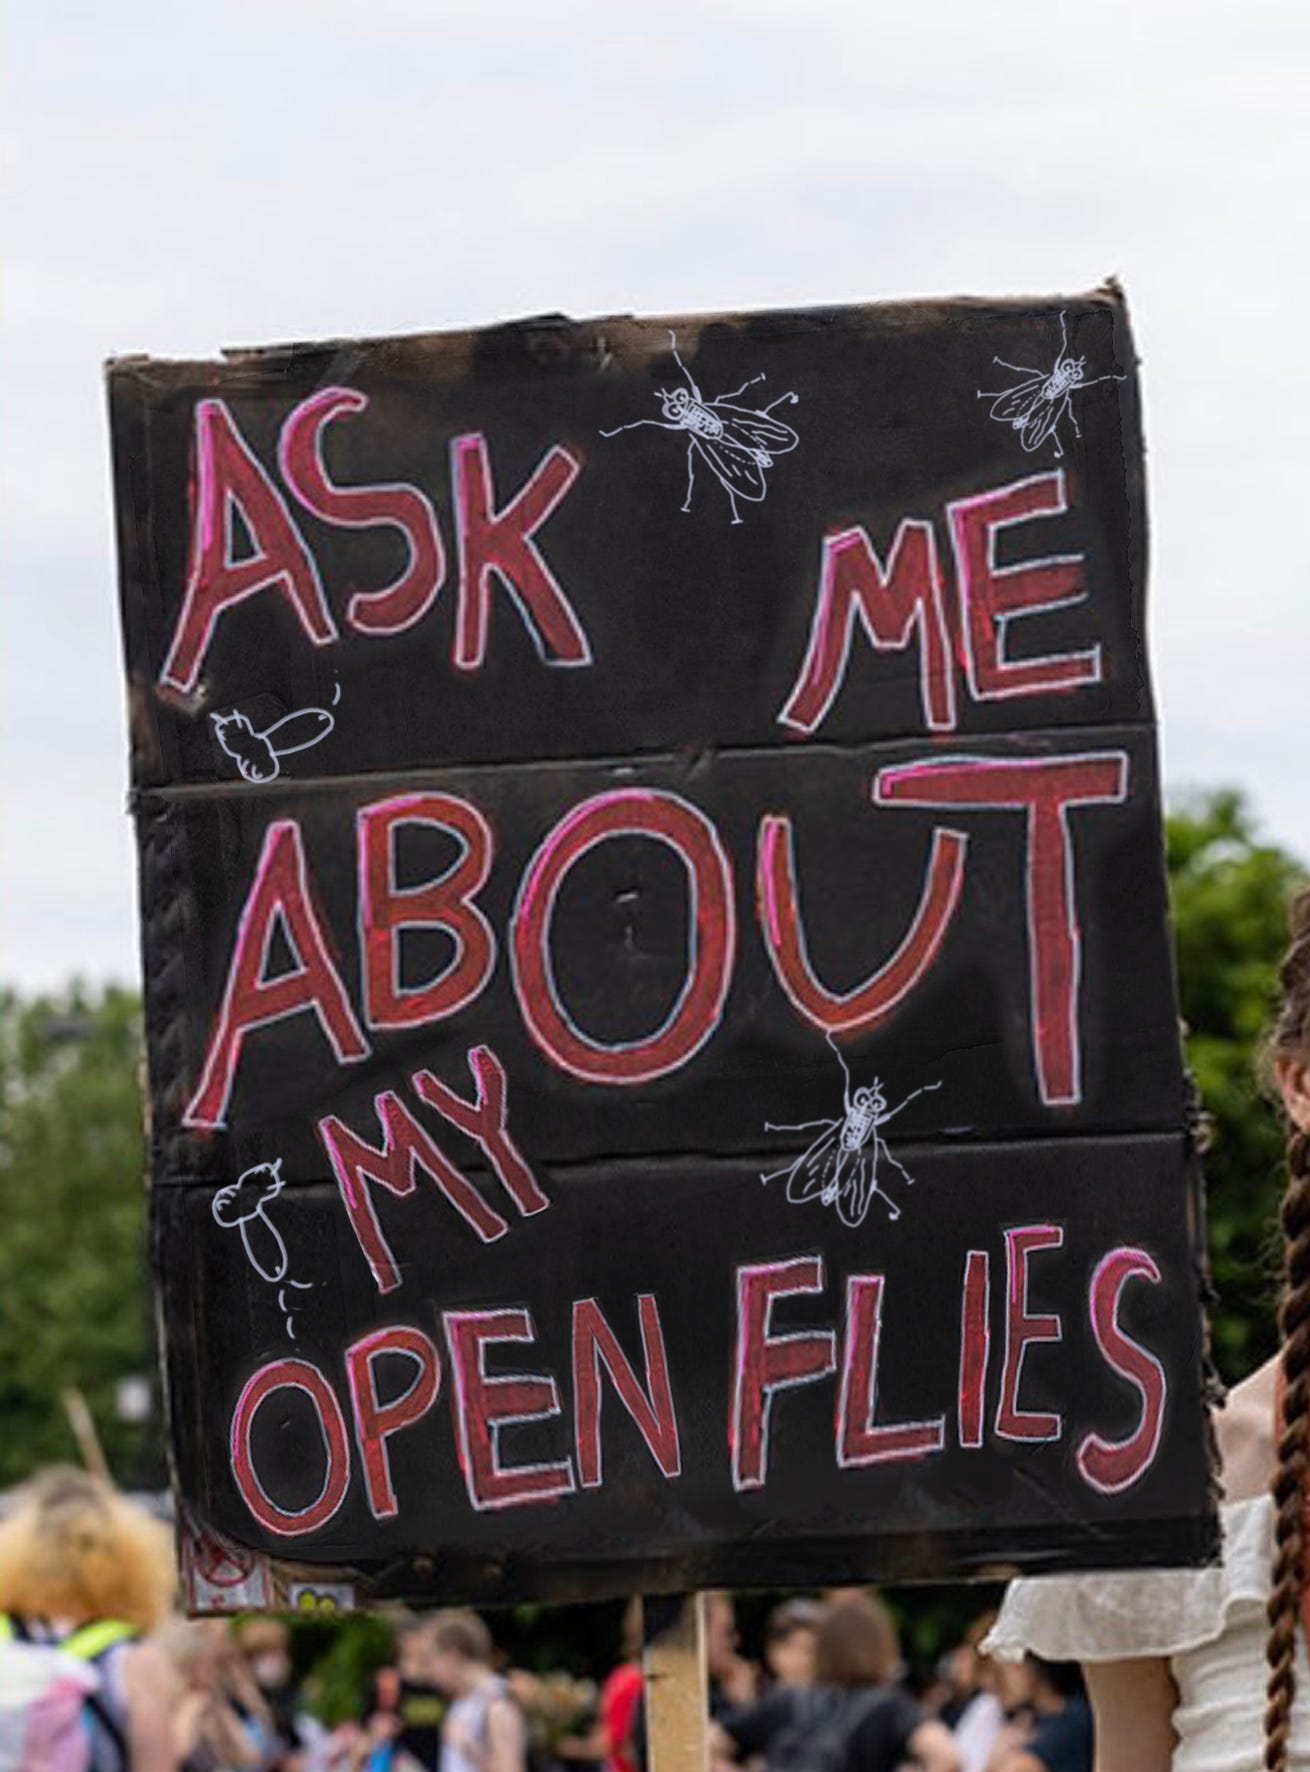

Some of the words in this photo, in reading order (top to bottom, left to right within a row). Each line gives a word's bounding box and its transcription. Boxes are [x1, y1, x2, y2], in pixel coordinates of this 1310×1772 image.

[162, 387, 591, 697] ASK
[779, 470, 1102, 734] ME
[181, 753, 1128, 1130] ABOUT
[318, 1046, 550, 1293] MY
[230, 1293, 681, 1537] OPEN
[731, 1224, 1167, 1496] FLIES
